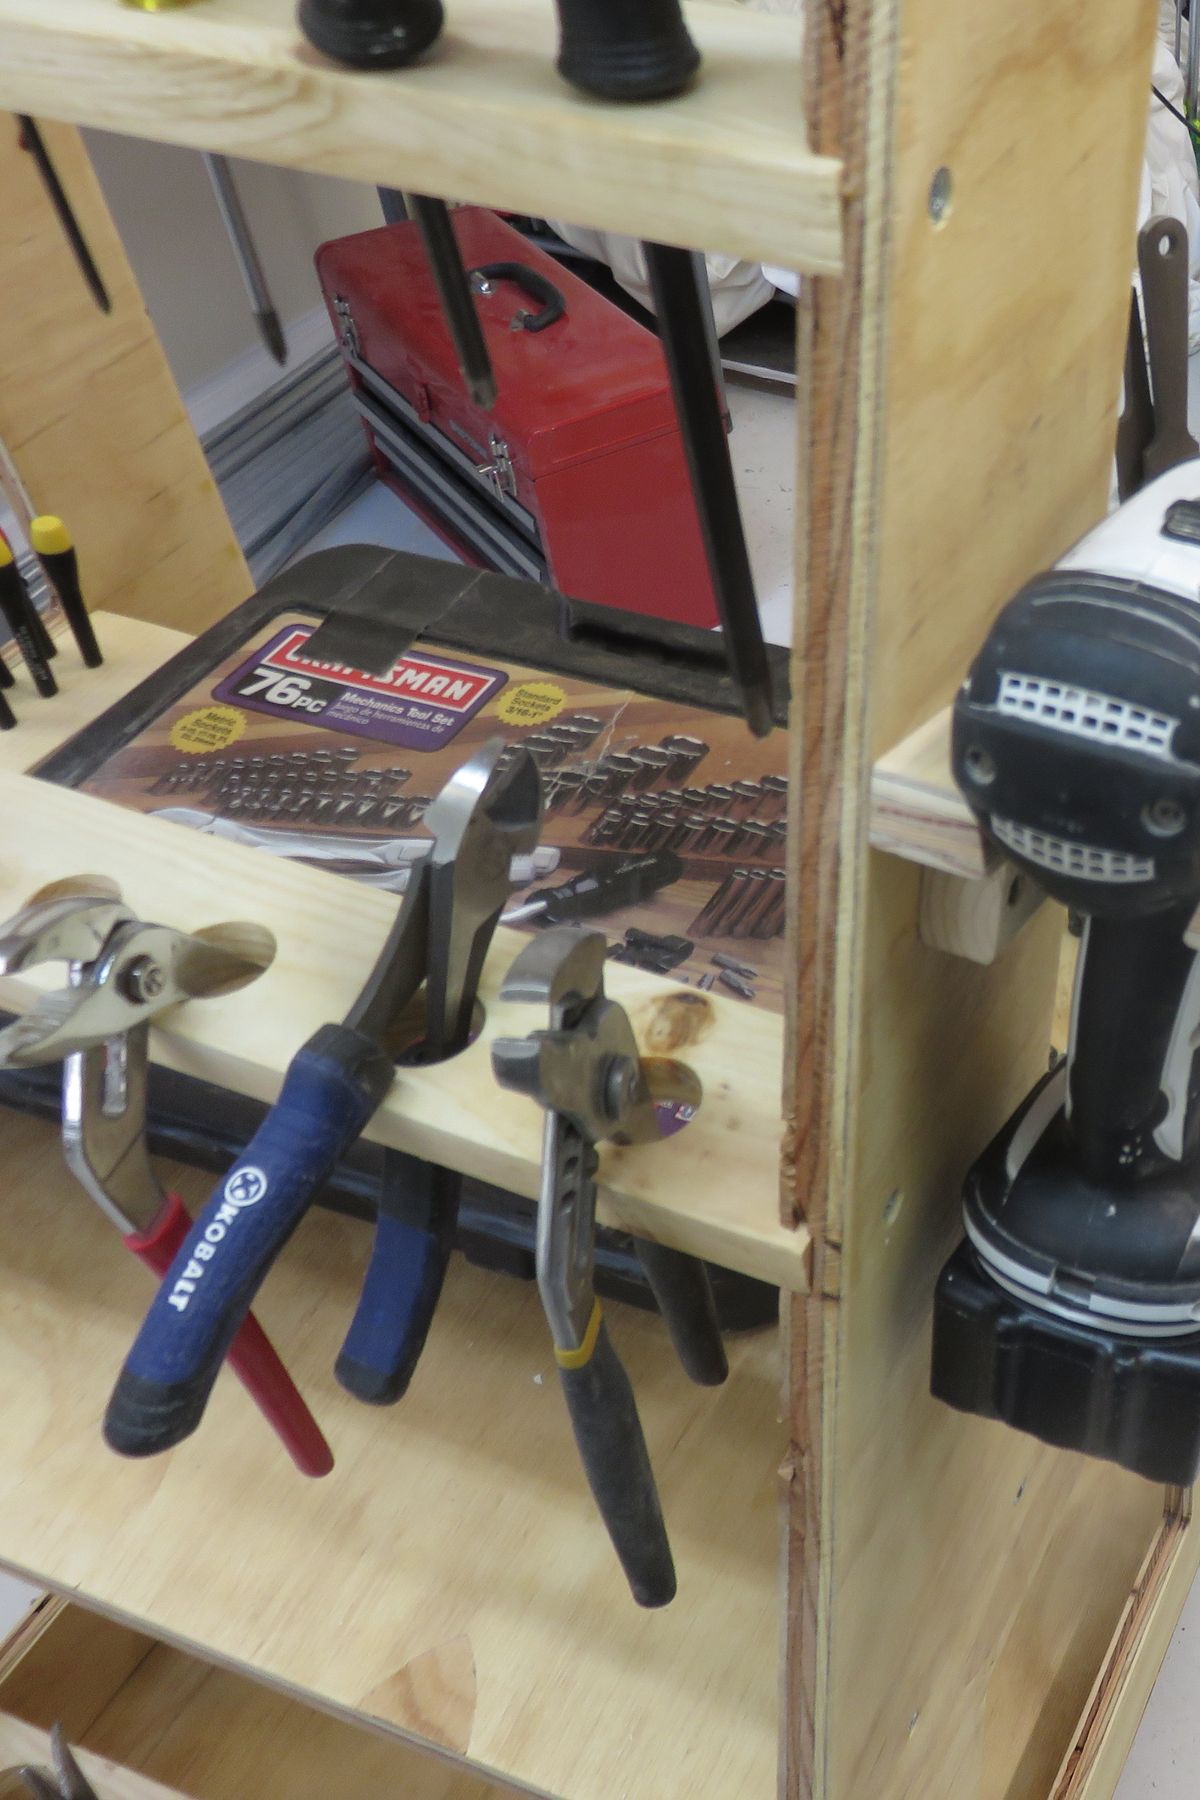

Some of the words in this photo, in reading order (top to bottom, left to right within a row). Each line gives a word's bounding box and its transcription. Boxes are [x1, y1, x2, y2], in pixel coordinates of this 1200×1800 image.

[340, 692, 404, 715] Mechanics
[407, 707, 432, 721] Tool
[431, 713, 455, 727] Set
[168, 1202, 240, 1312] KOBALT
